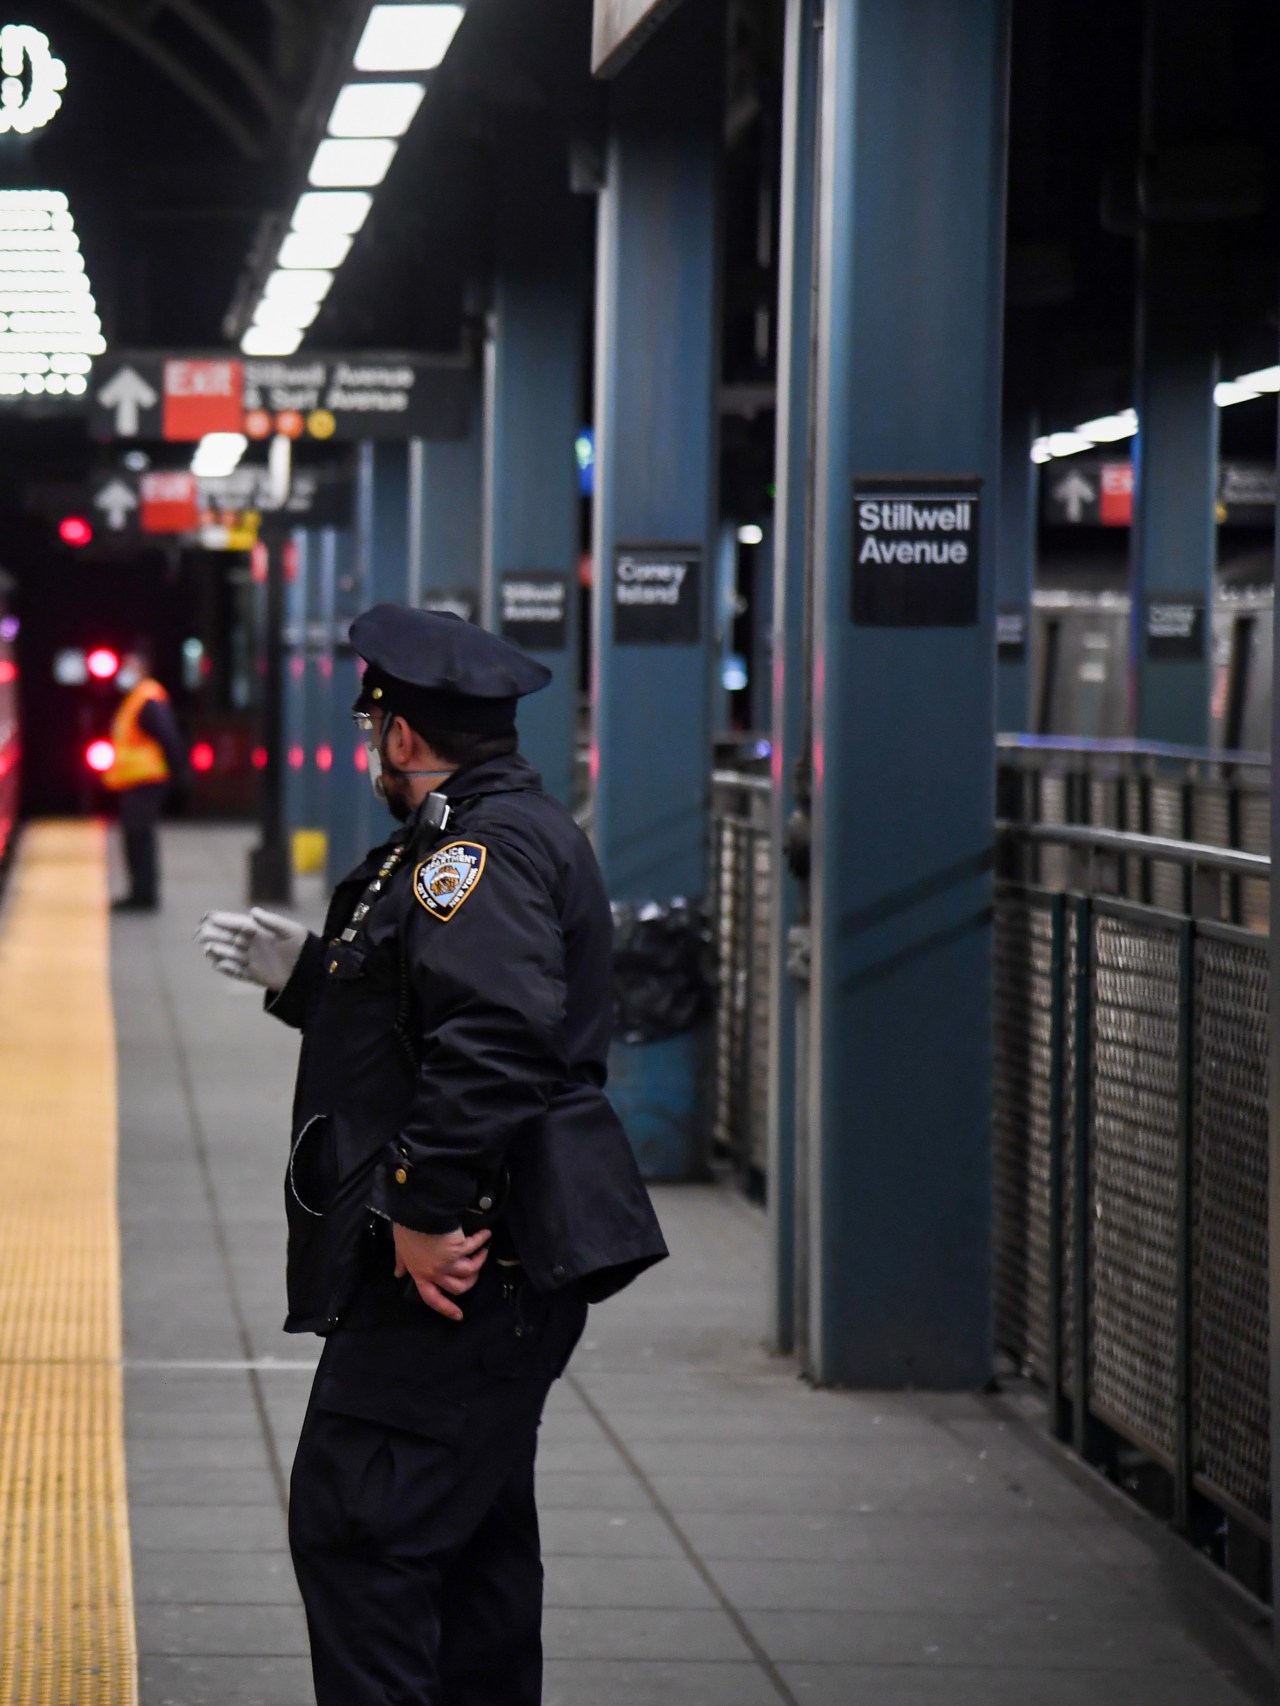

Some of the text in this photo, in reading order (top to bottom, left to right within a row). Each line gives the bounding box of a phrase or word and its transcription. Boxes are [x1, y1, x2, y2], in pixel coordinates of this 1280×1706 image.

[859, 502, 970, 531] Stillwell
[859, 535, 968, 564] Avenue
[617, 557, 686, 587] Coney
[617, 583, 679, 604] Island
[432, 847, 464, 862] POLICE
[417, 882, 438, 909] CITY OF
[448, 867, 479, 908] NEW YORK
